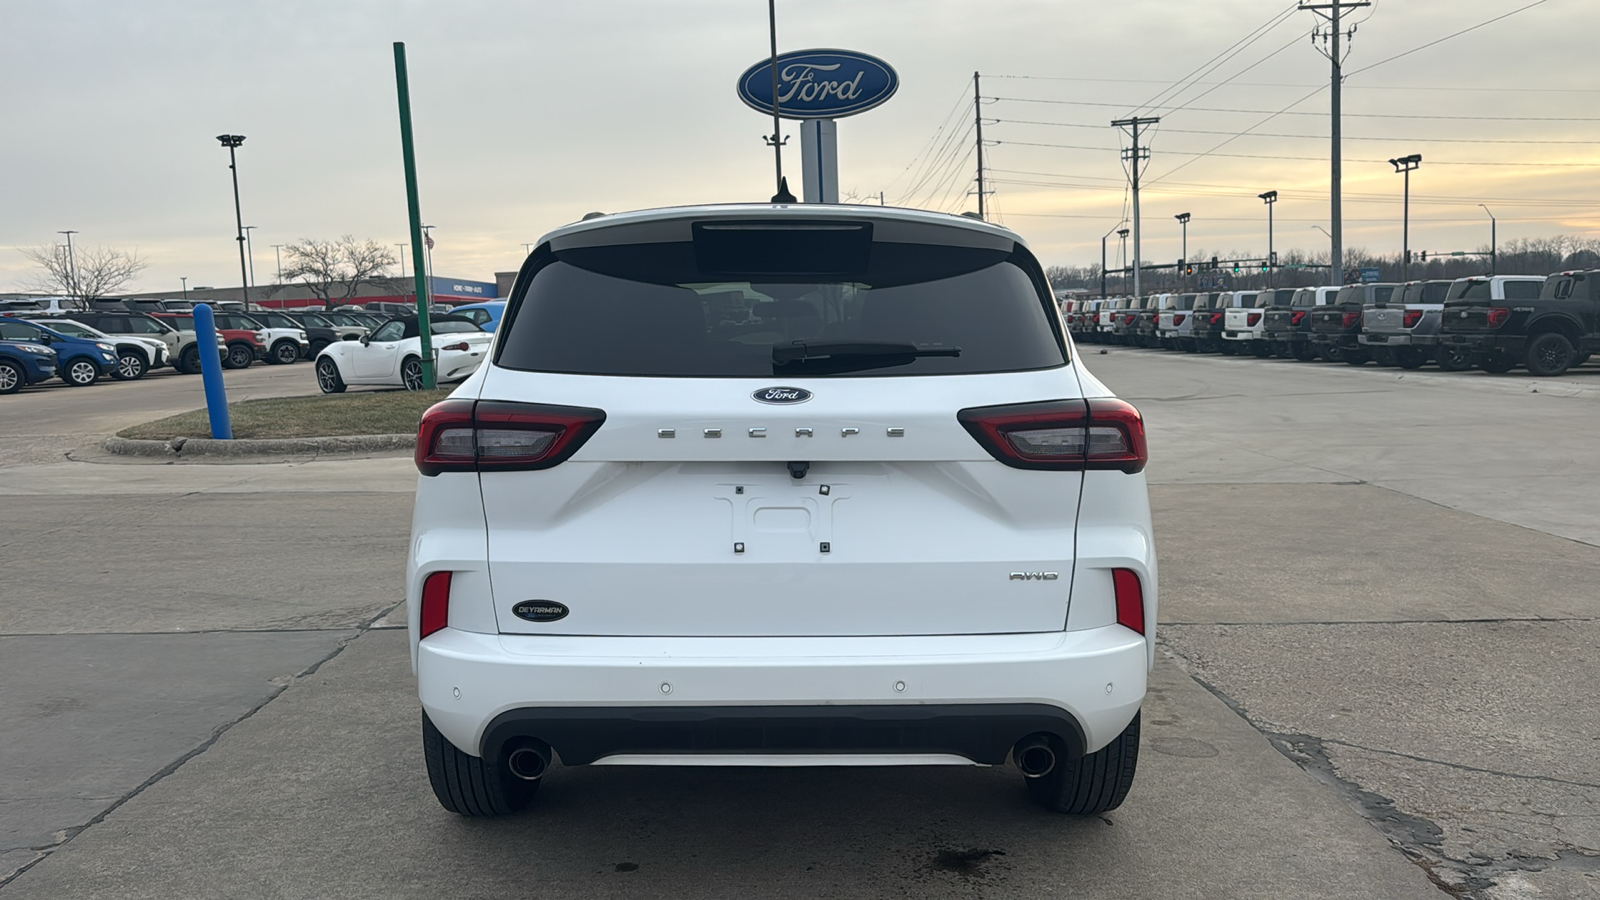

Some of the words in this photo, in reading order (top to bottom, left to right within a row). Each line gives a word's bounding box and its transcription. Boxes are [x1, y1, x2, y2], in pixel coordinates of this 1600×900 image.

[777, 63, 865, 102] Ford
[765, 388, 799, 400] Ford
[657, 427, 905, 438] ESCAPE
[1009, 571, 1058, 581] AWD
[518, 606, 563, 614] DEYARMAN
